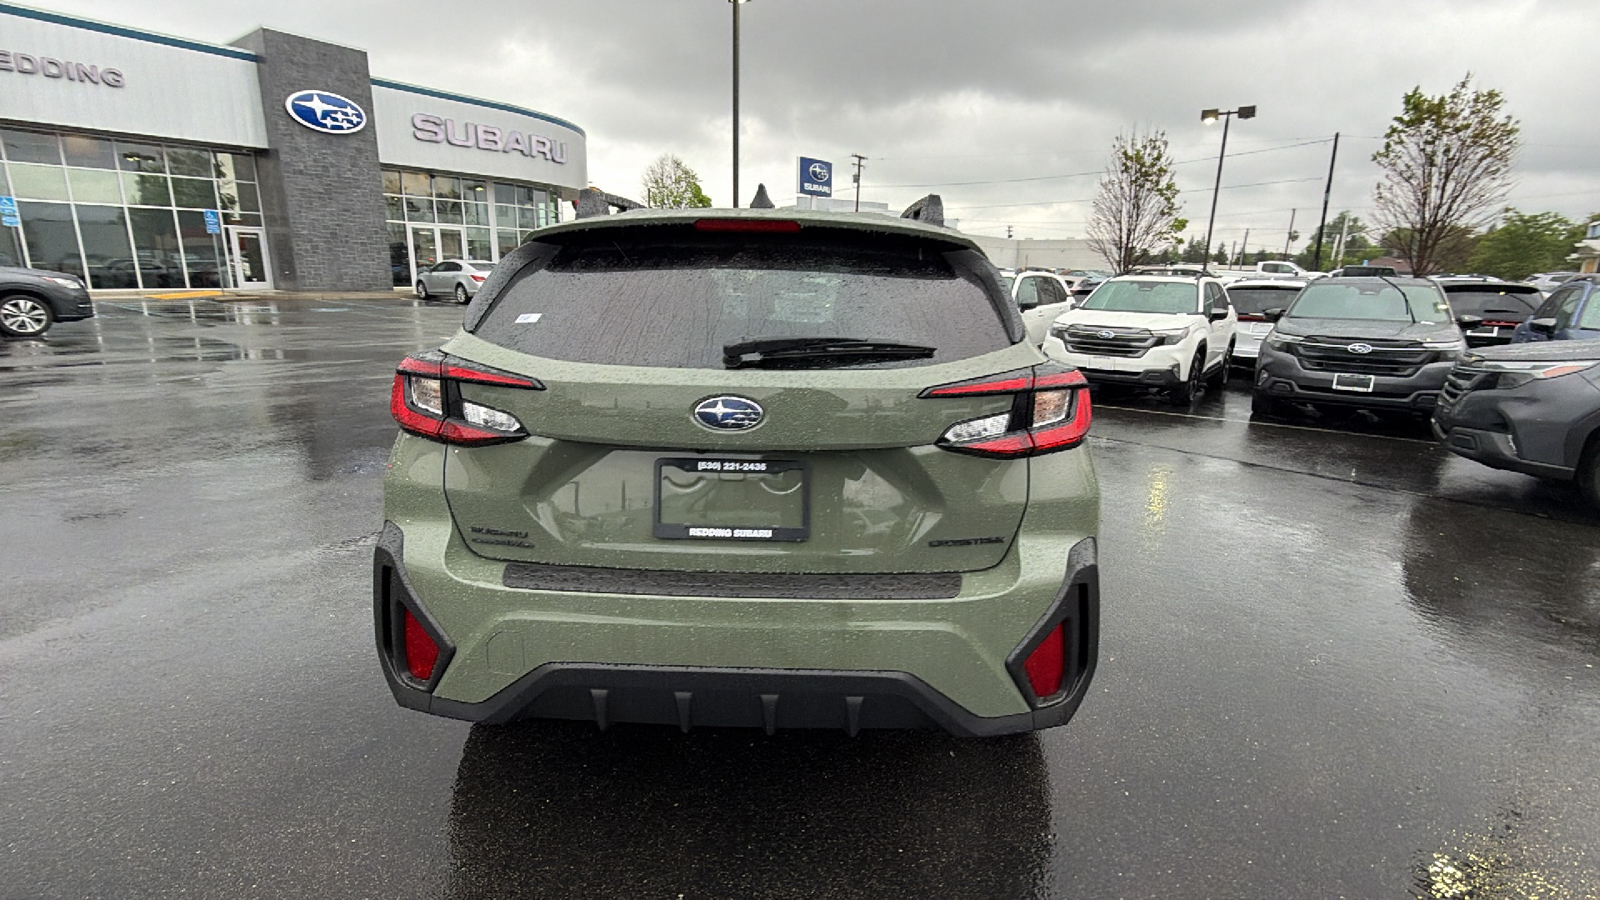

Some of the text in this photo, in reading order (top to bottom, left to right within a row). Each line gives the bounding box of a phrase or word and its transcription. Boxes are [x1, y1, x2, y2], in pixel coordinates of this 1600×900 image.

[0, 50, 125, 88] EDDING
[412, 113, 567, 165] SUBARU
[804, 183, 830, 193] SUBARU
[689, 528, 773, 538] REDDING SUBARU
